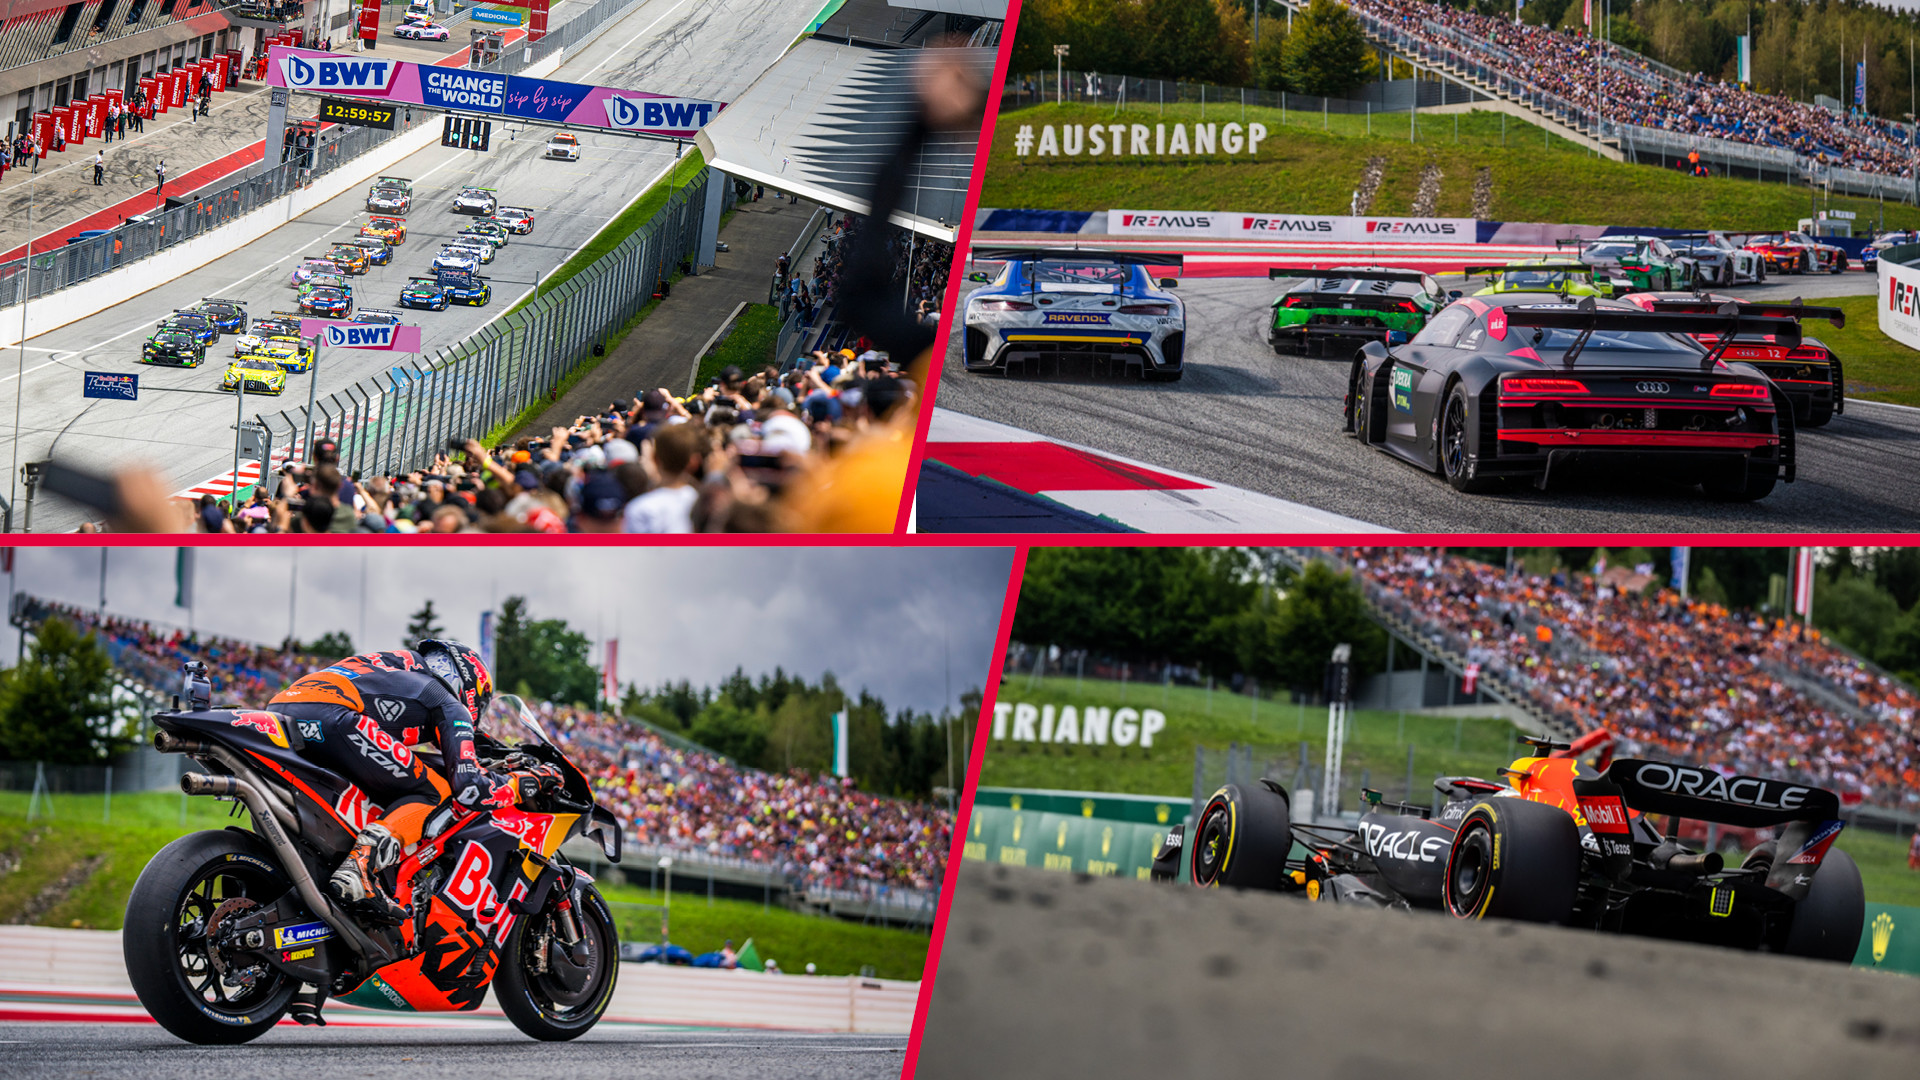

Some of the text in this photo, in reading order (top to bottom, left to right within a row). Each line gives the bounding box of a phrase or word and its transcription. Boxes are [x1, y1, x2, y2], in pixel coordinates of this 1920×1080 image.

[319, 62, 388, 85] BWT
[427, 72, 504, 95] CHANGE
[427, 86, 503, 108] THE WORLD
[508, 85, 573, 113] sip by sip
[326, 104, 392, 123] 12:59:57
[643, 102, 713, 127] BWT
[1014, 122, 1268, 156] #AUSTRIANGP
[1132, 215, 1211, 228] REMUS
[1252, 218, 1333, 232] REMUS
[1376, 222, 1456, 235] REMUS
[1048, 314, 1106, 323] RAVENOL
[347, 327, 391, 345] BWT
[1767, 350, 1781, 359] 12
[1635, 763, 1811, 809] ORACLE
[1583, 804, 1624, 824] Mobil 1
[1165, 833, 1183, 848] ESSO
[1611, 840, 1631, 855] Tezos
[296, 925, 332, 939] MICHEL
